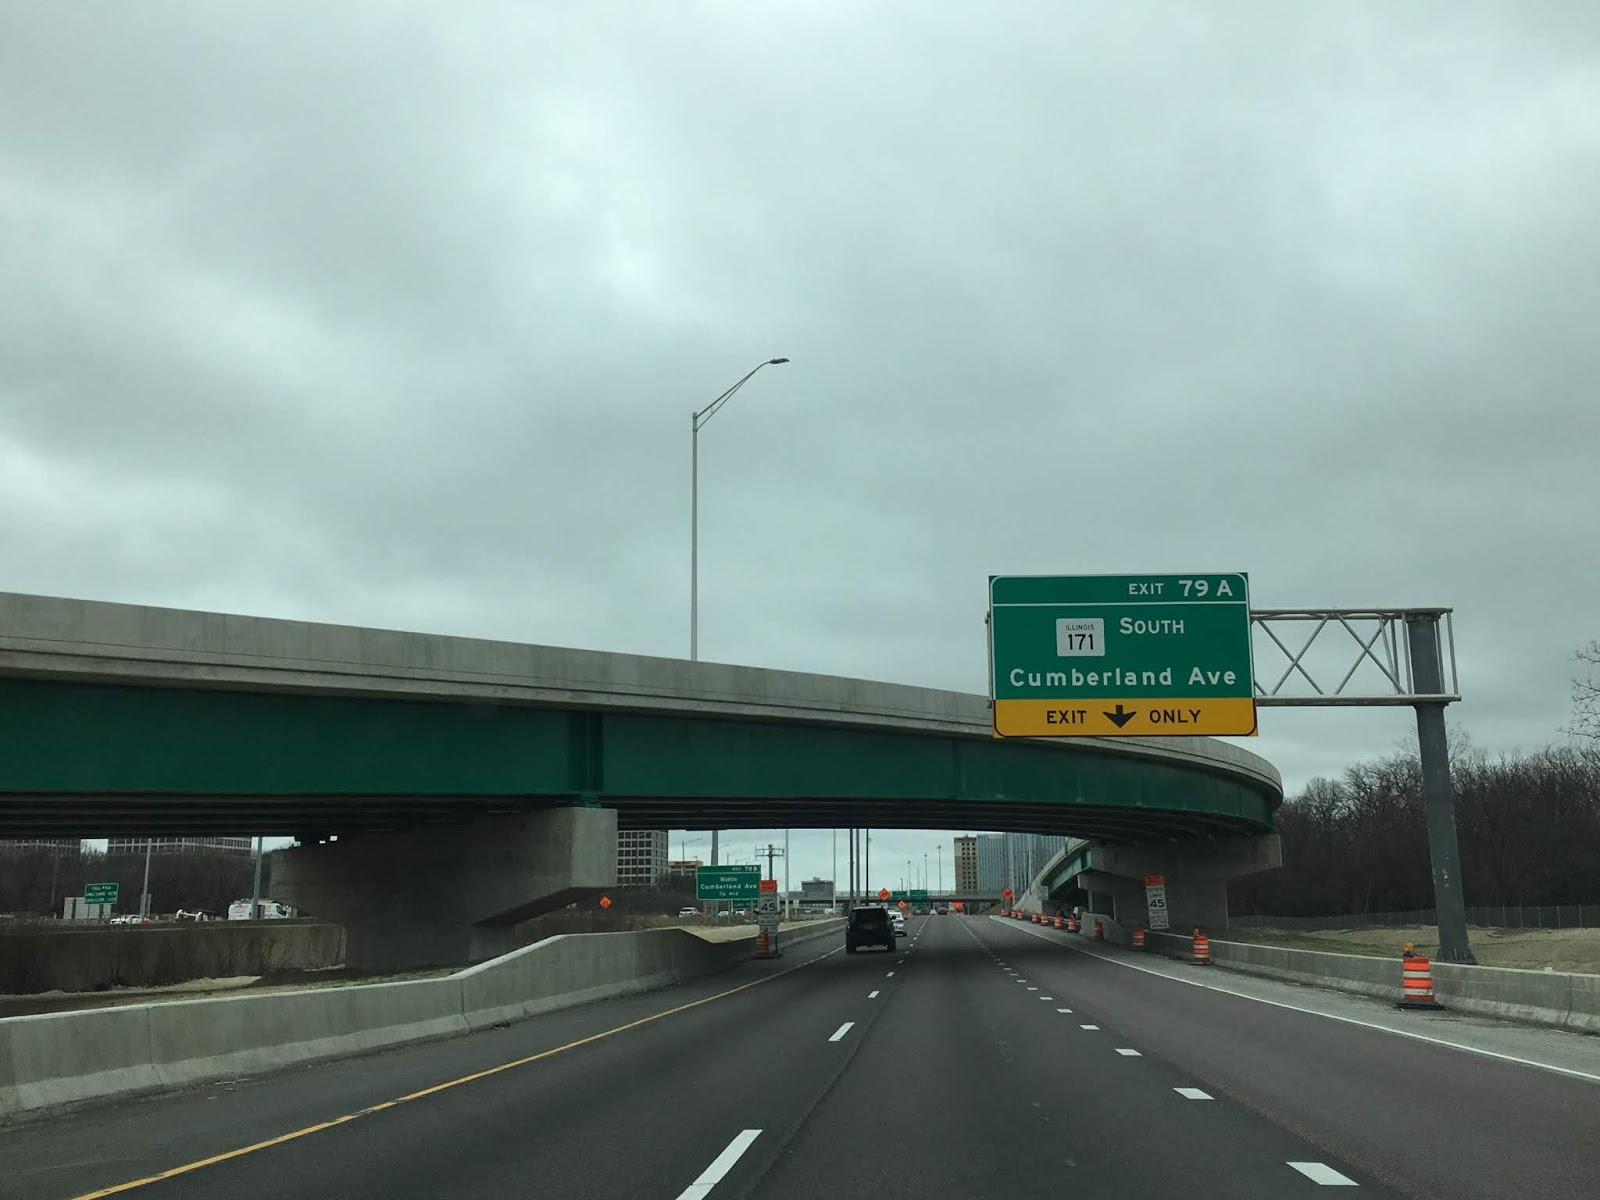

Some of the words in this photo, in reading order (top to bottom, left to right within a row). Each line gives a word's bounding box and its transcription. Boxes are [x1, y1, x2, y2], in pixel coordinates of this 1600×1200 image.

[1128, 583, 1164, 595] EXIT
[1178, 580, 1209, 597] 79
[1216, 580, 1233, 596] A
[1119, 617, 1185, 634] SOUTH
[1067, 634, 1094, 650] 171
[1010, 667, 1172, 687] Cumberland
[1188, 667, 1236, 685] Ave
[1046, 710, 1087, 724] EXIT
[1149, 709, 1201, 723] ONLY
[761, 903, 776, 912] 45
[1150, 899, 1165, 908] 45
